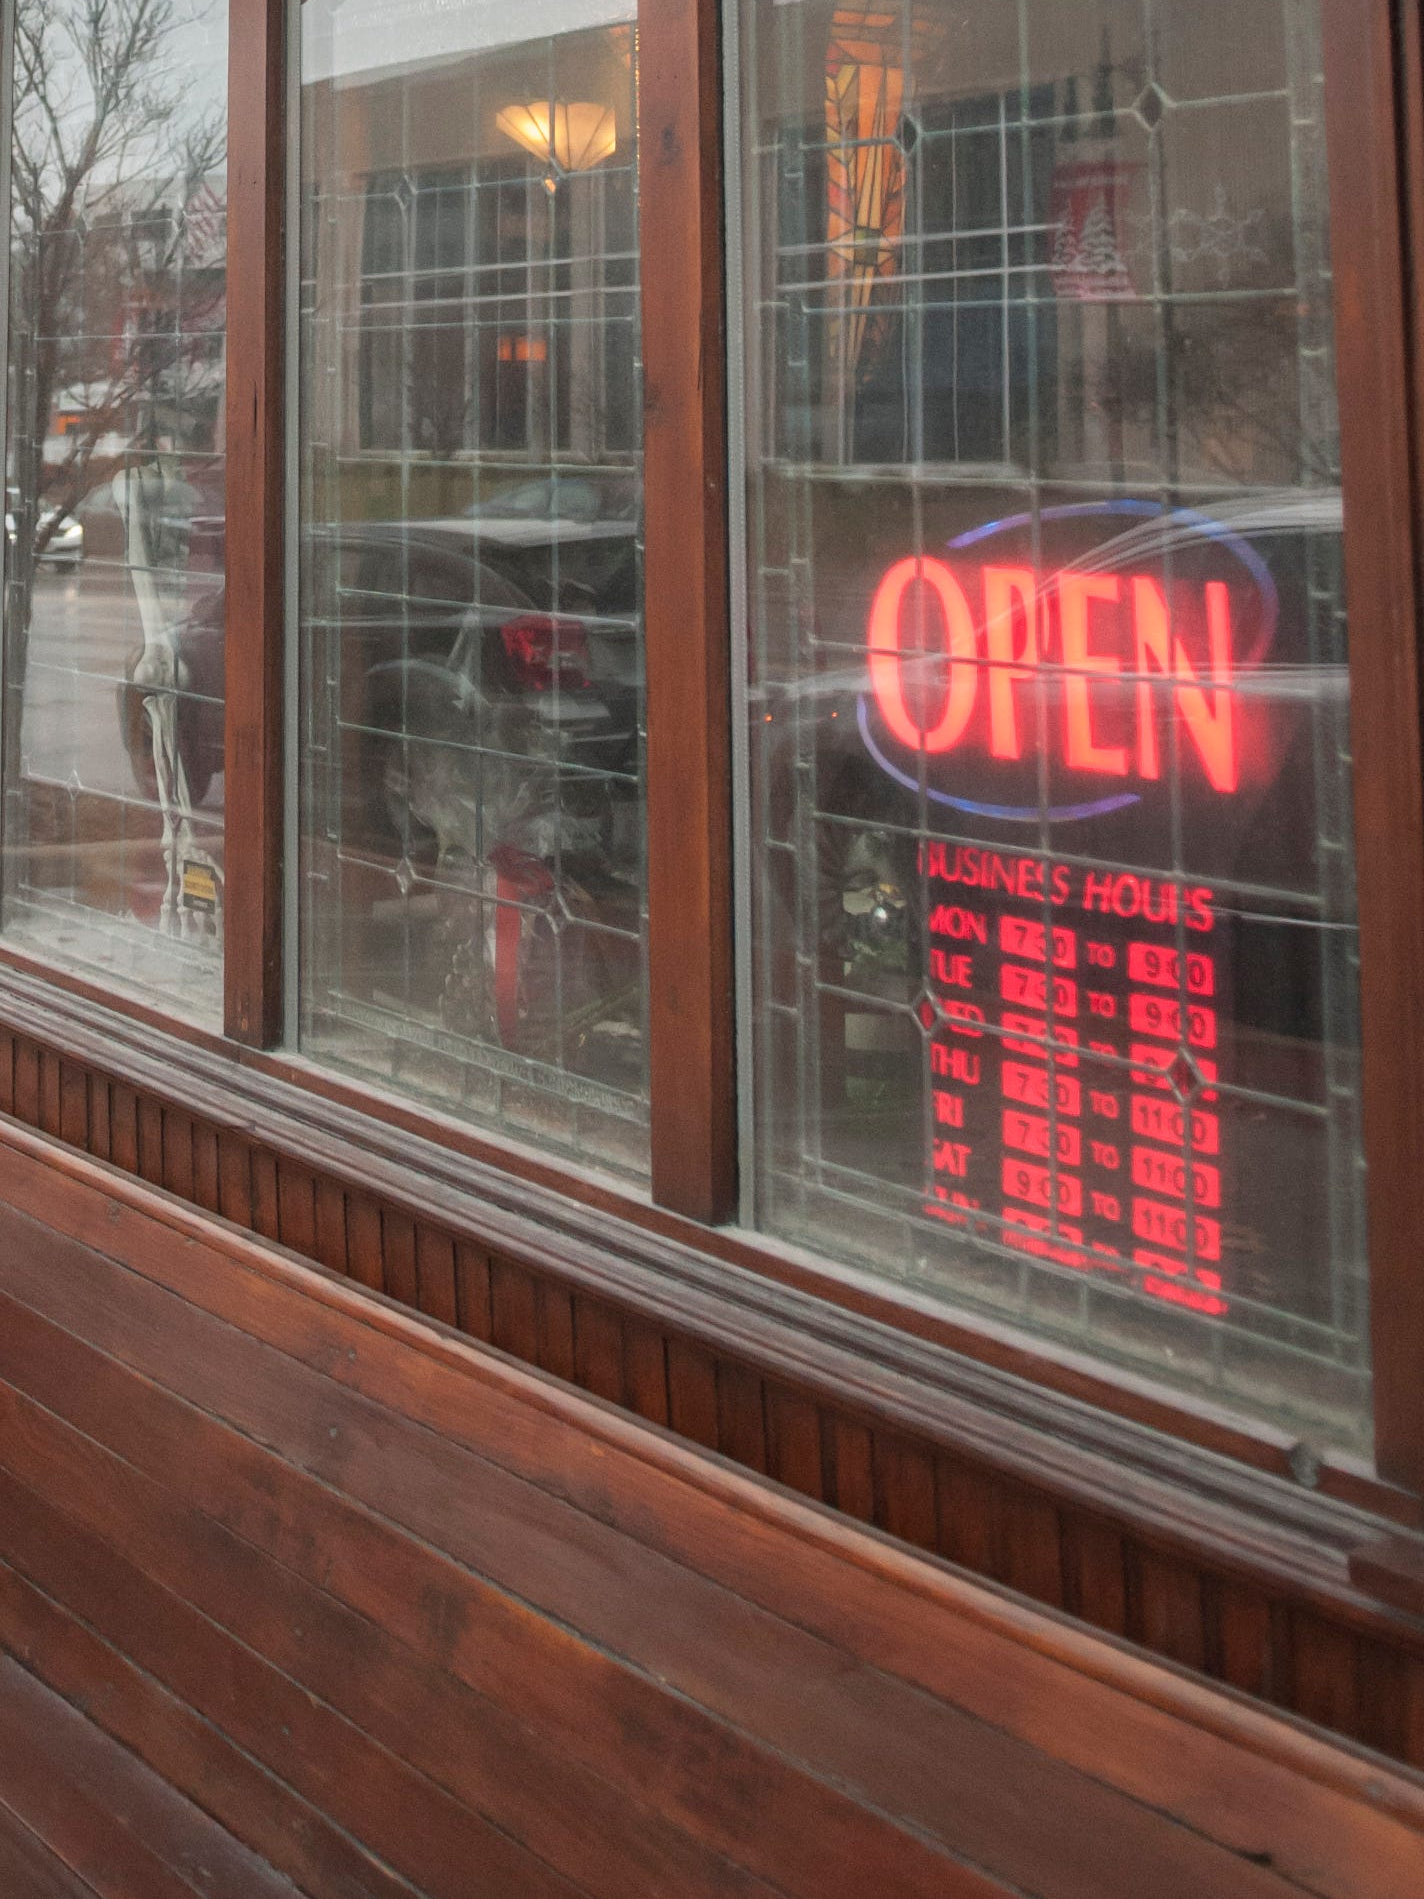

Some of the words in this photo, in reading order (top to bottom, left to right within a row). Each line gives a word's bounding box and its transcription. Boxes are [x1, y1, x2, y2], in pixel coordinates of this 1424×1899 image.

[866, 553, 1240, 795] OPEN
[1086, 941, 1116, 969] TO
[1087, 991, 1117, 1019] TO
[1089, 1089, 1119, 1119] TO
[931, 1089, 965, 1129] RI
[1089, 1140, 1121, 1170] TO
[1090, 1190, 1121, 1221] TO
